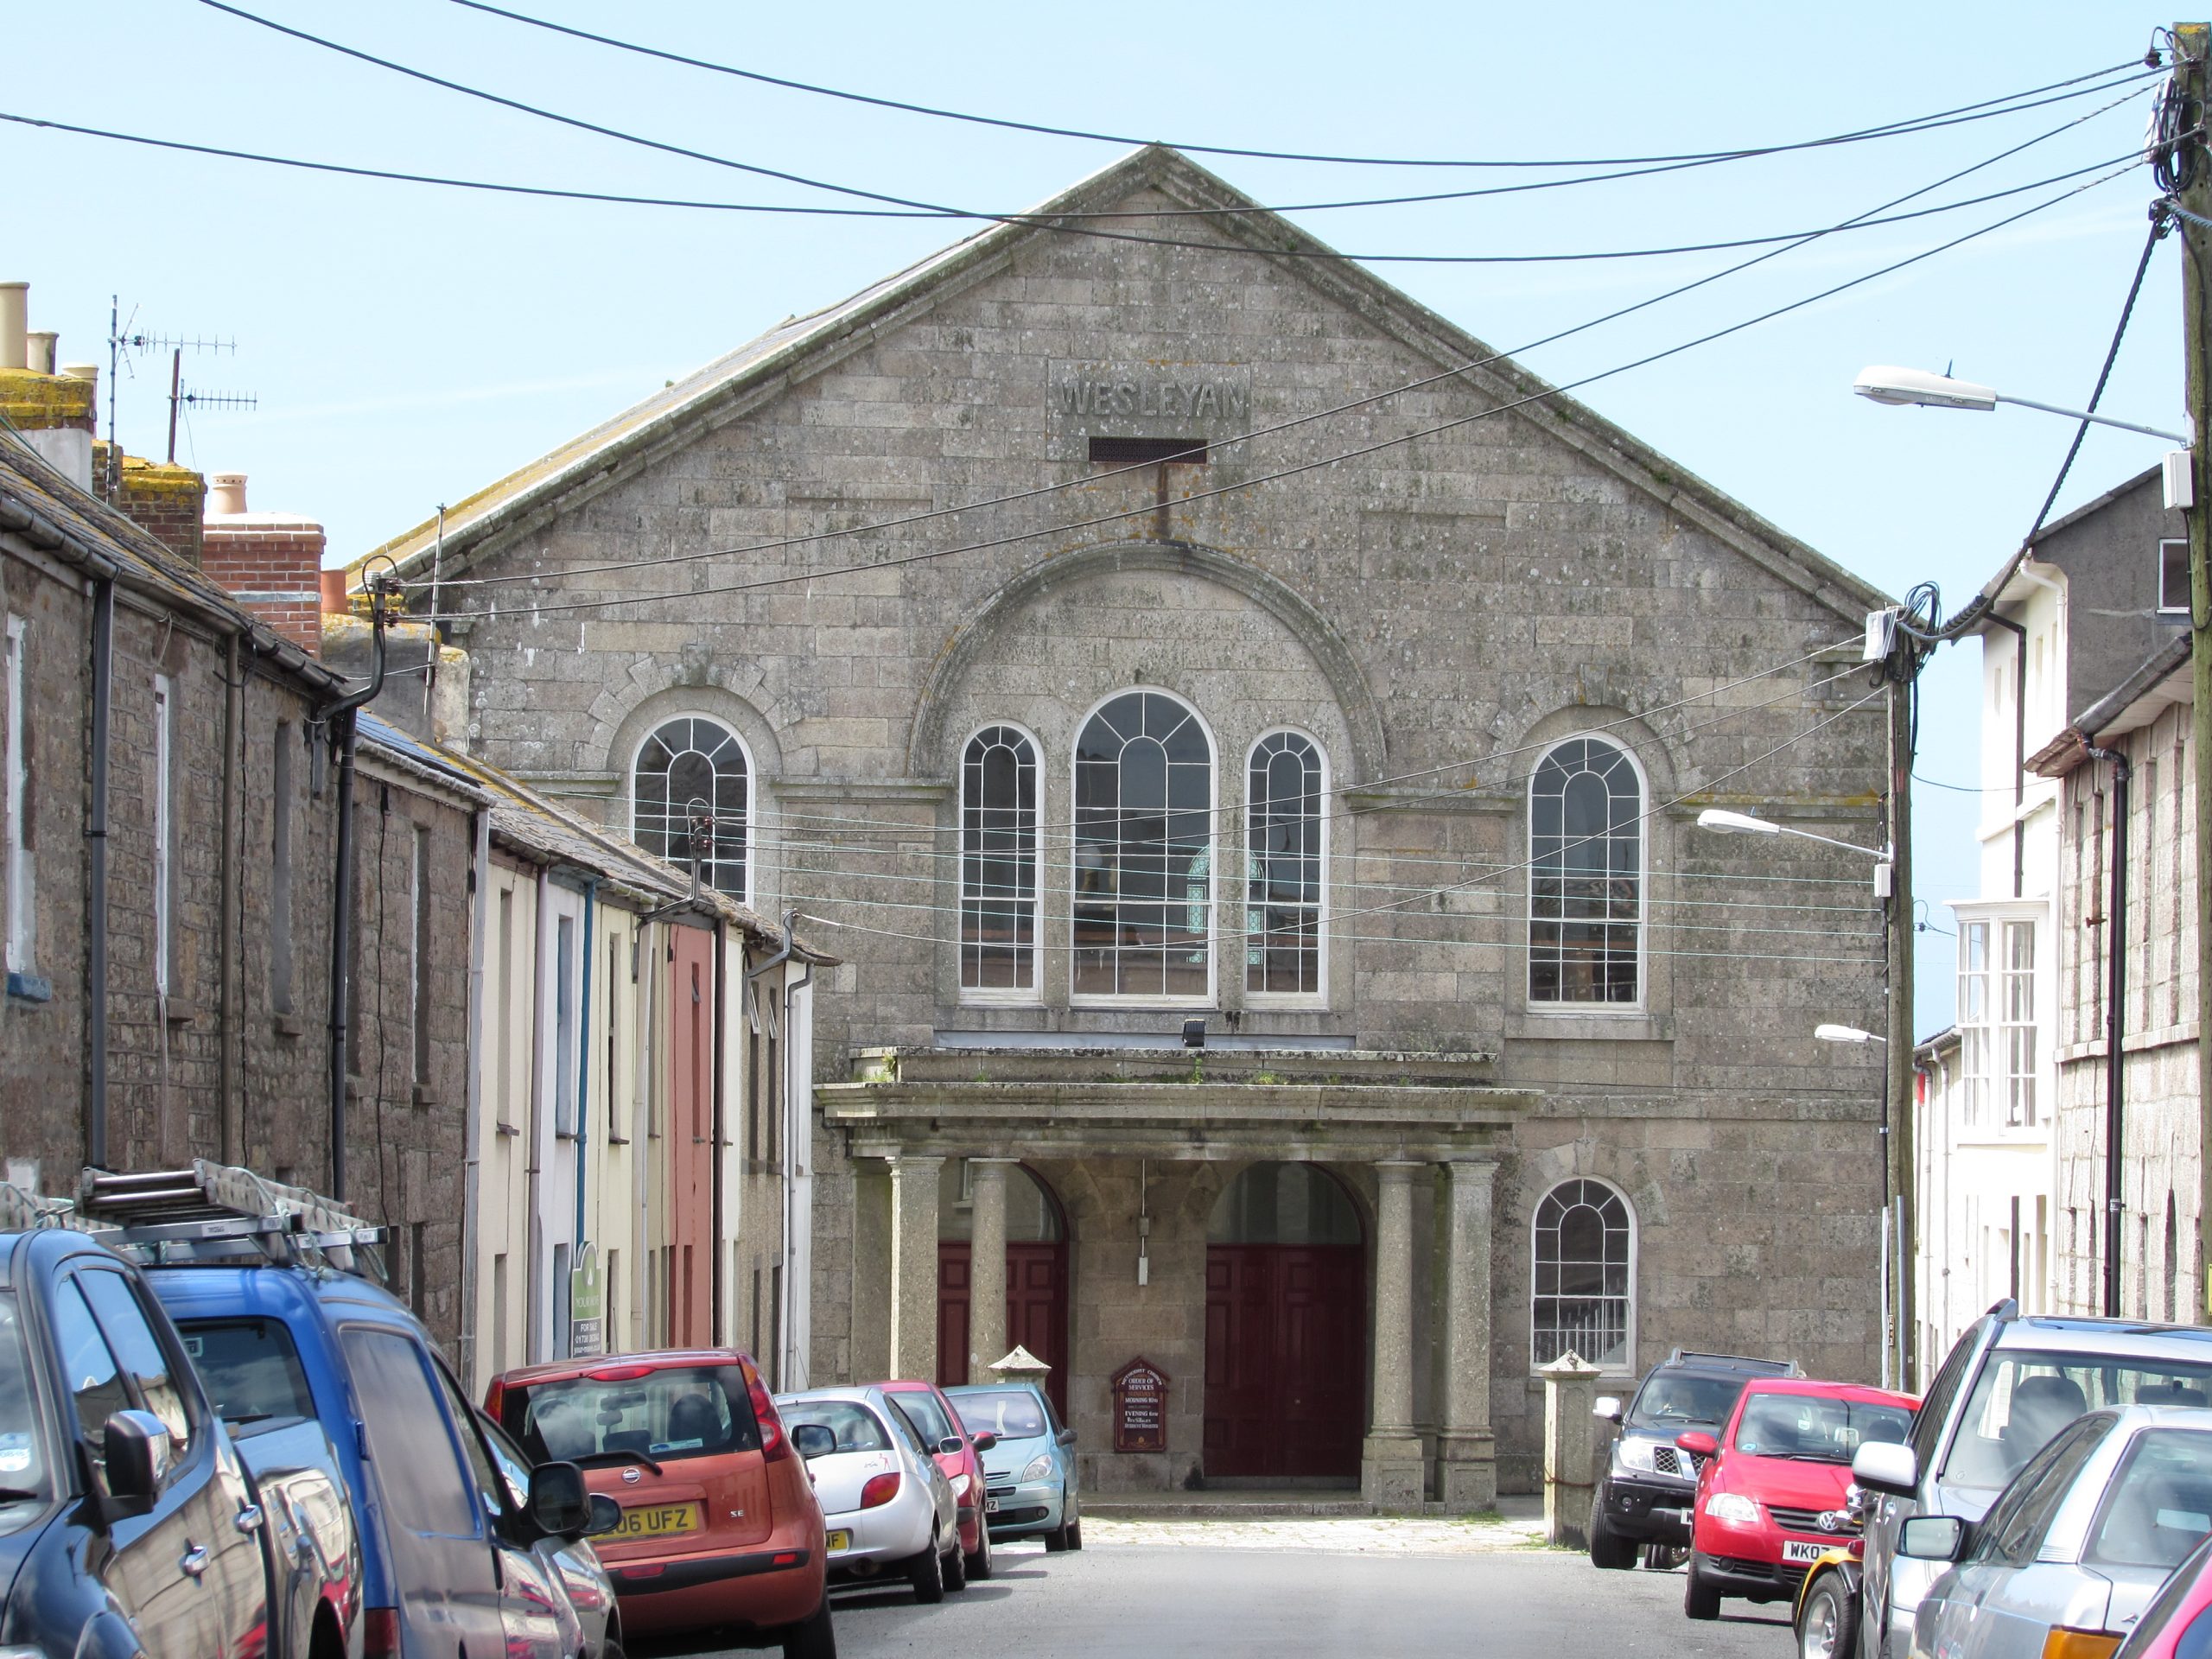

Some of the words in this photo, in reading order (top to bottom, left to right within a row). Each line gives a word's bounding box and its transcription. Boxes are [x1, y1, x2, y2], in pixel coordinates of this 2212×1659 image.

[1059, 378, 1247, 419] WESLEYAN
[580, 1324, 589, 1332] FOR
[603, 1514, 642, 1535] 06
[646, 1509, 689, 1531] UFZ
[729, 1510, 745, 1518] SE
